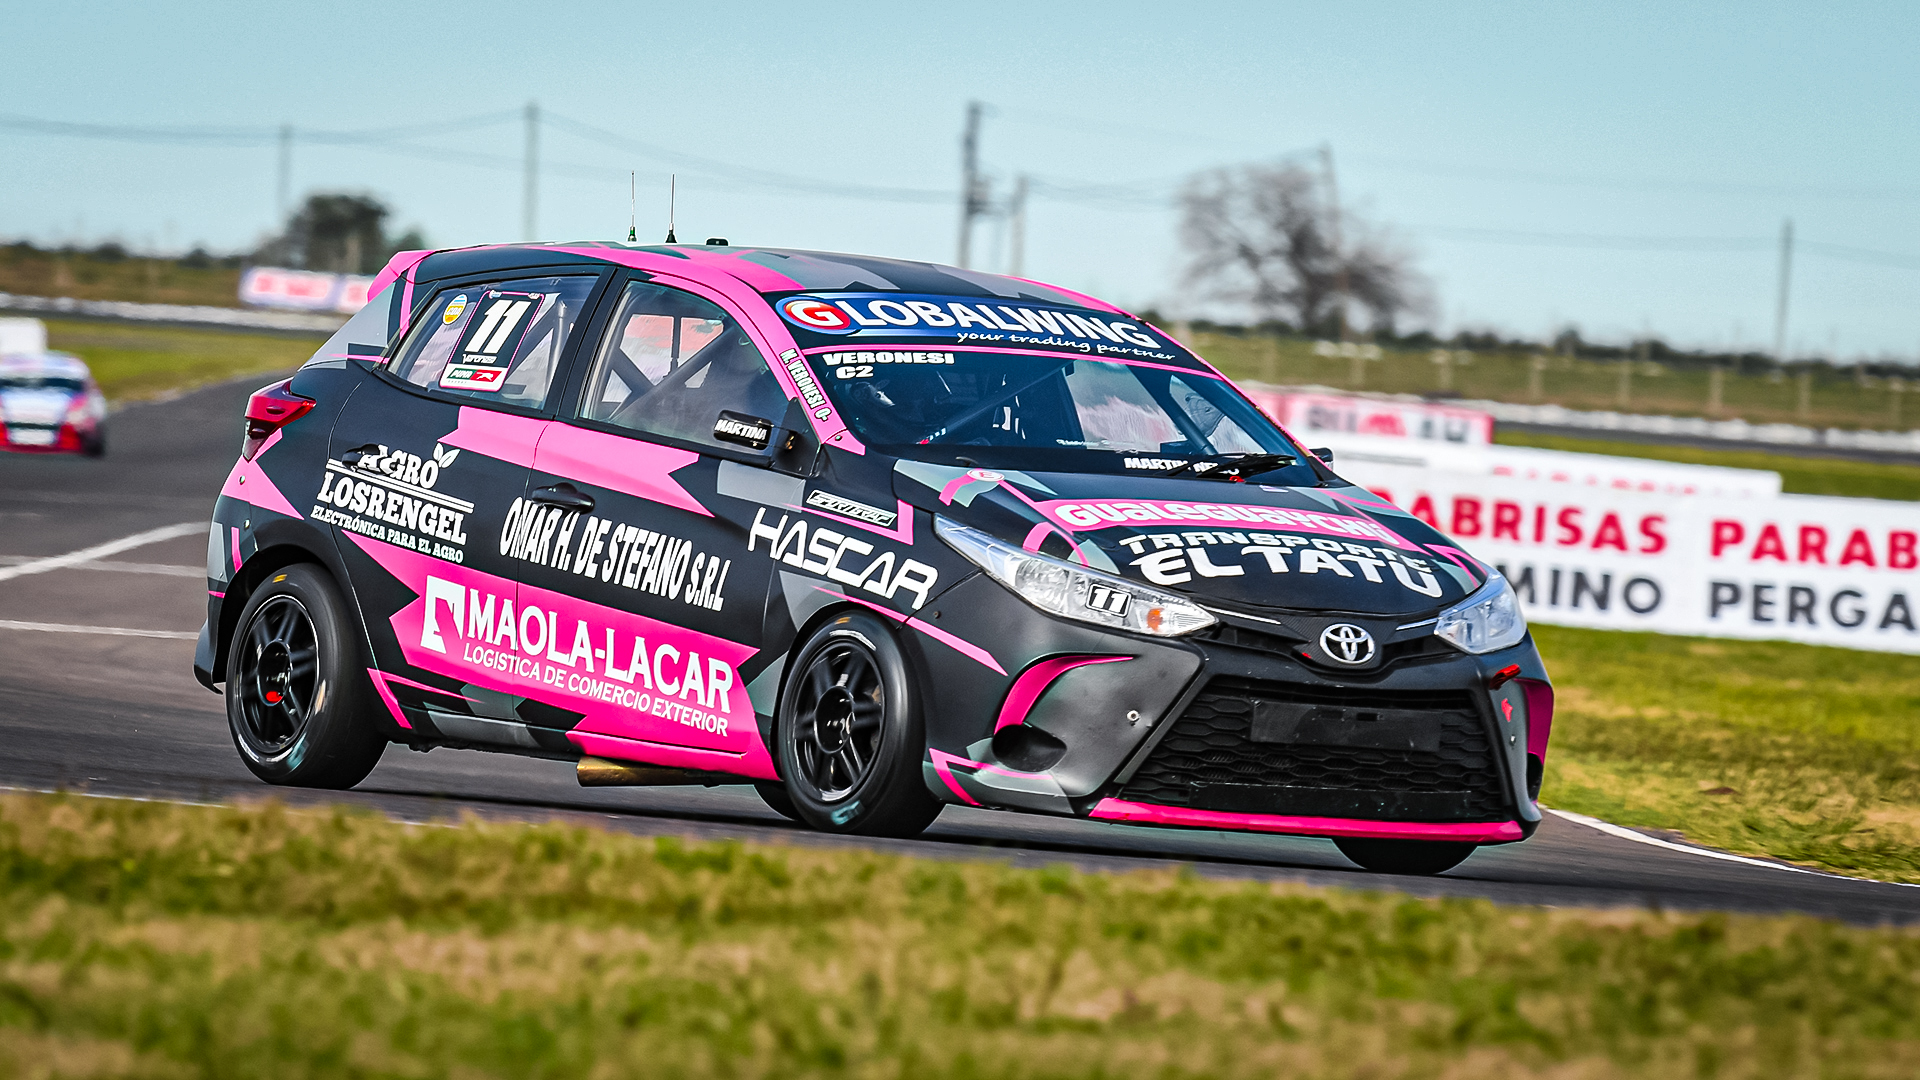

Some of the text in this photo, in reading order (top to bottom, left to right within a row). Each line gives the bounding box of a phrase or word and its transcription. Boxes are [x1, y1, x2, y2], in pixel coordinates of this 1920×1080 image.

[464, 299, 532, 354] 11
[790, 299, 1161, 348] GLOBALWING
[957, 331, 1175, 360] your trading partner
[786, 359, 827, 410] VERONESI
[822, 352, 955, 366] VERONESI
[835, 365, 874, 379] C2
[714, 419, 768, 441] MARTINA
[357, 444, 440, 489] AGRO
[310, 504, 464, 564] ELECTRÓNICA PARA EL AGRO
[316, 471, 467, 546] LOSRENGEL
[1368, 487, 1919, 570] ABRISAS PARAB
[500, 496, 563, 566] OMAR
[572, 515, 613, 579] DE
[601, 522, 693, 600] STEFANO
[747, 506, 939, 610] HASCAR
[1118, 531, 1433, 574] TRANSPORTE
[1129, 547, 1245, 586] EL
[1091, 588, 1128, 613] 11
[1709, 580, 1917, 631] PERGA
[467, 588, 734, 714] MAOLA-LACAR
[463, 642, 729, 737] LOGISTICA DE COMERCIO EXTERIOR
